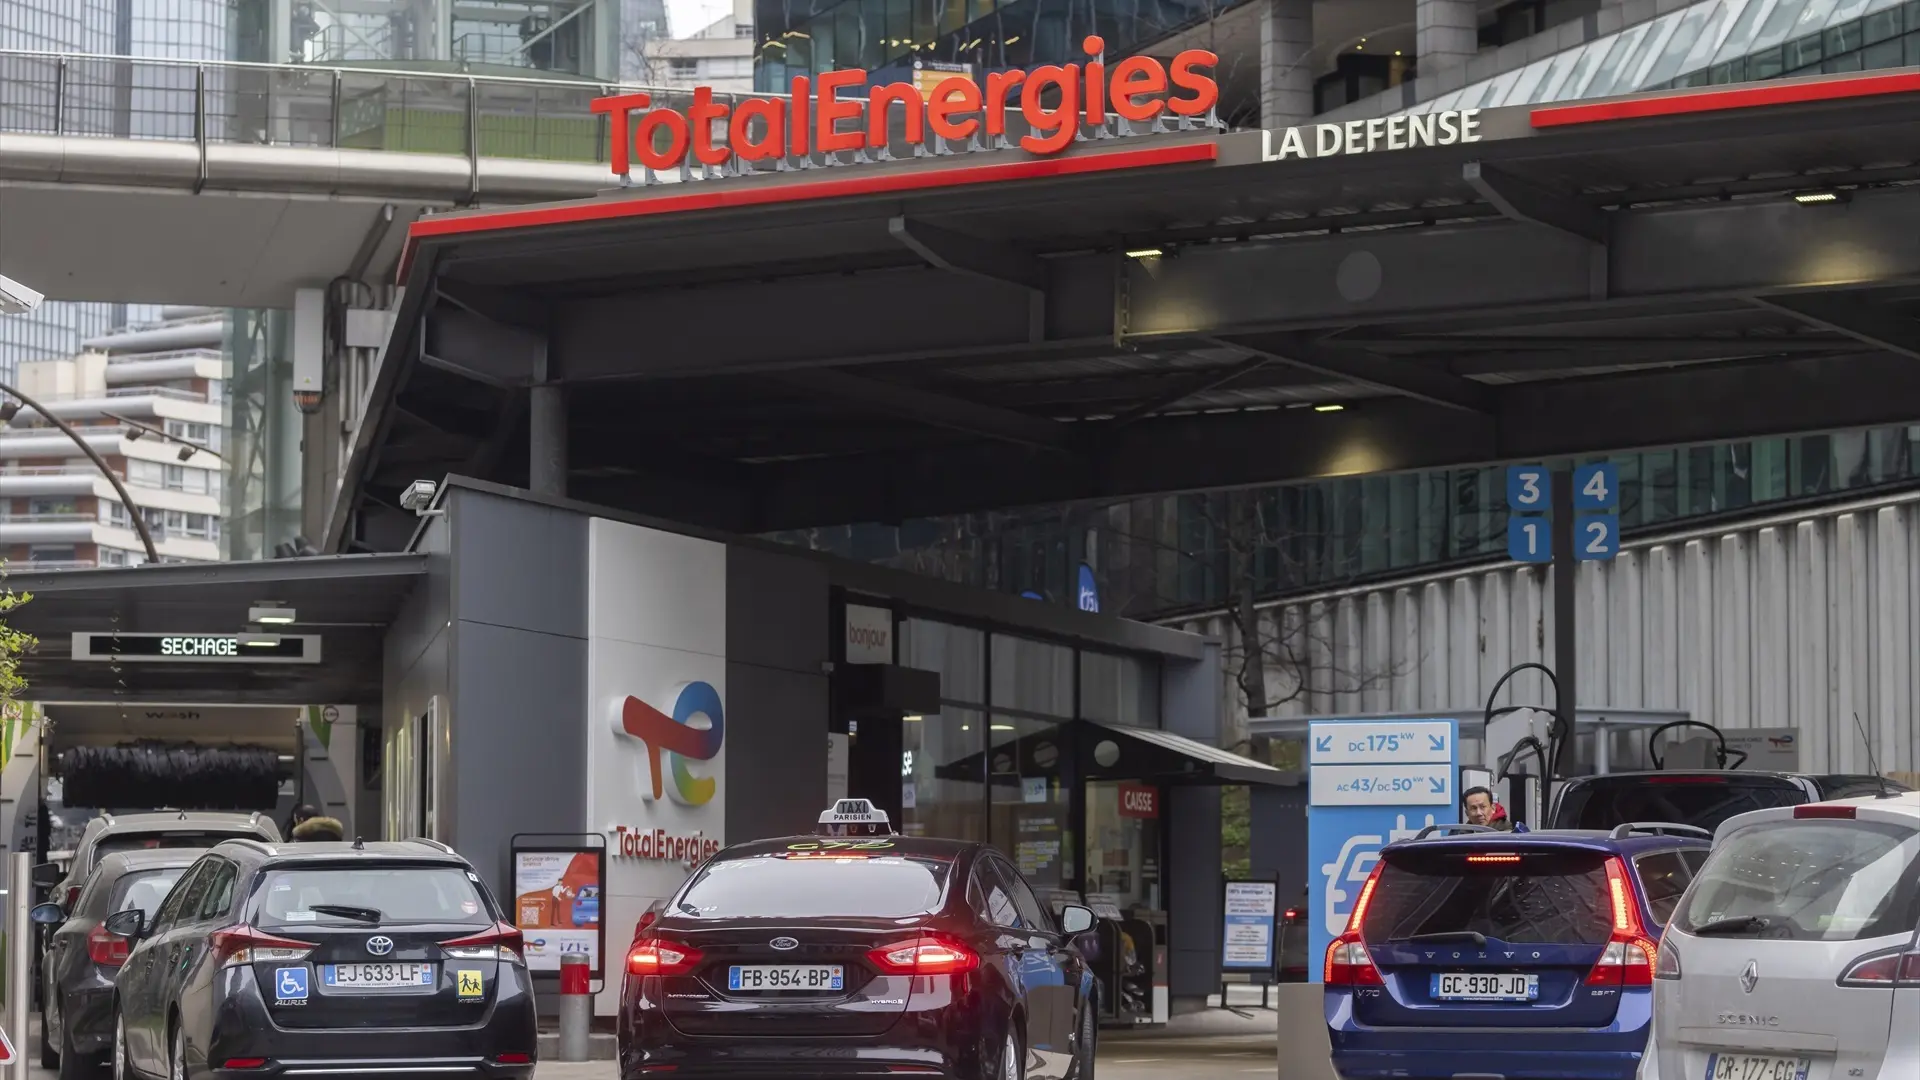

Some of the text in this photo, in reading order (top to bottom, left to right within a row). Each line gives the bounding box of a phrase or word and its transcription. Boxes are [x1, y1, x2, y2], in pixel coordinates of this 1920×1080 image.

[590, 35, 1220, 175] TotalEnergies
[1262, 108, 1483, 162] LA DEFENSE
[1518, 473, 1540, 504] 3
[1583, 470, 1608, 502] 4
[1523, 523, 1536, 554] 1
[1586, 521, 1609, 553] 2
[161, 637, 238, 656] SECHAGE
[849, 622, 887, 650] bonjour
[1348, 742, 1365, 752] DC
[1366, 735, 1399, 751] 175
[1336, 784, 1349, 792] AC
[1392, 778, 1412, 791] 50
[840, 802, 866, 814] TAXI
[1124, 791, 1153, 811] CAISSE
[616, 825, 719, 868] TotalEnergies
[776, 939, 794, 948] Ford
[336, 964, 420, 982] EJ-633-LF
[422, 974, 432, 983] 92
[741, 968, 830, 988] FB-954-BP
[832, 978, 841, 988] 93
[1442, 976, 1526, 994] GC-930-JD
[1528, 987, 1538, 995] 44
[1715, 1056, 1796, 1080] CR-177-CG
